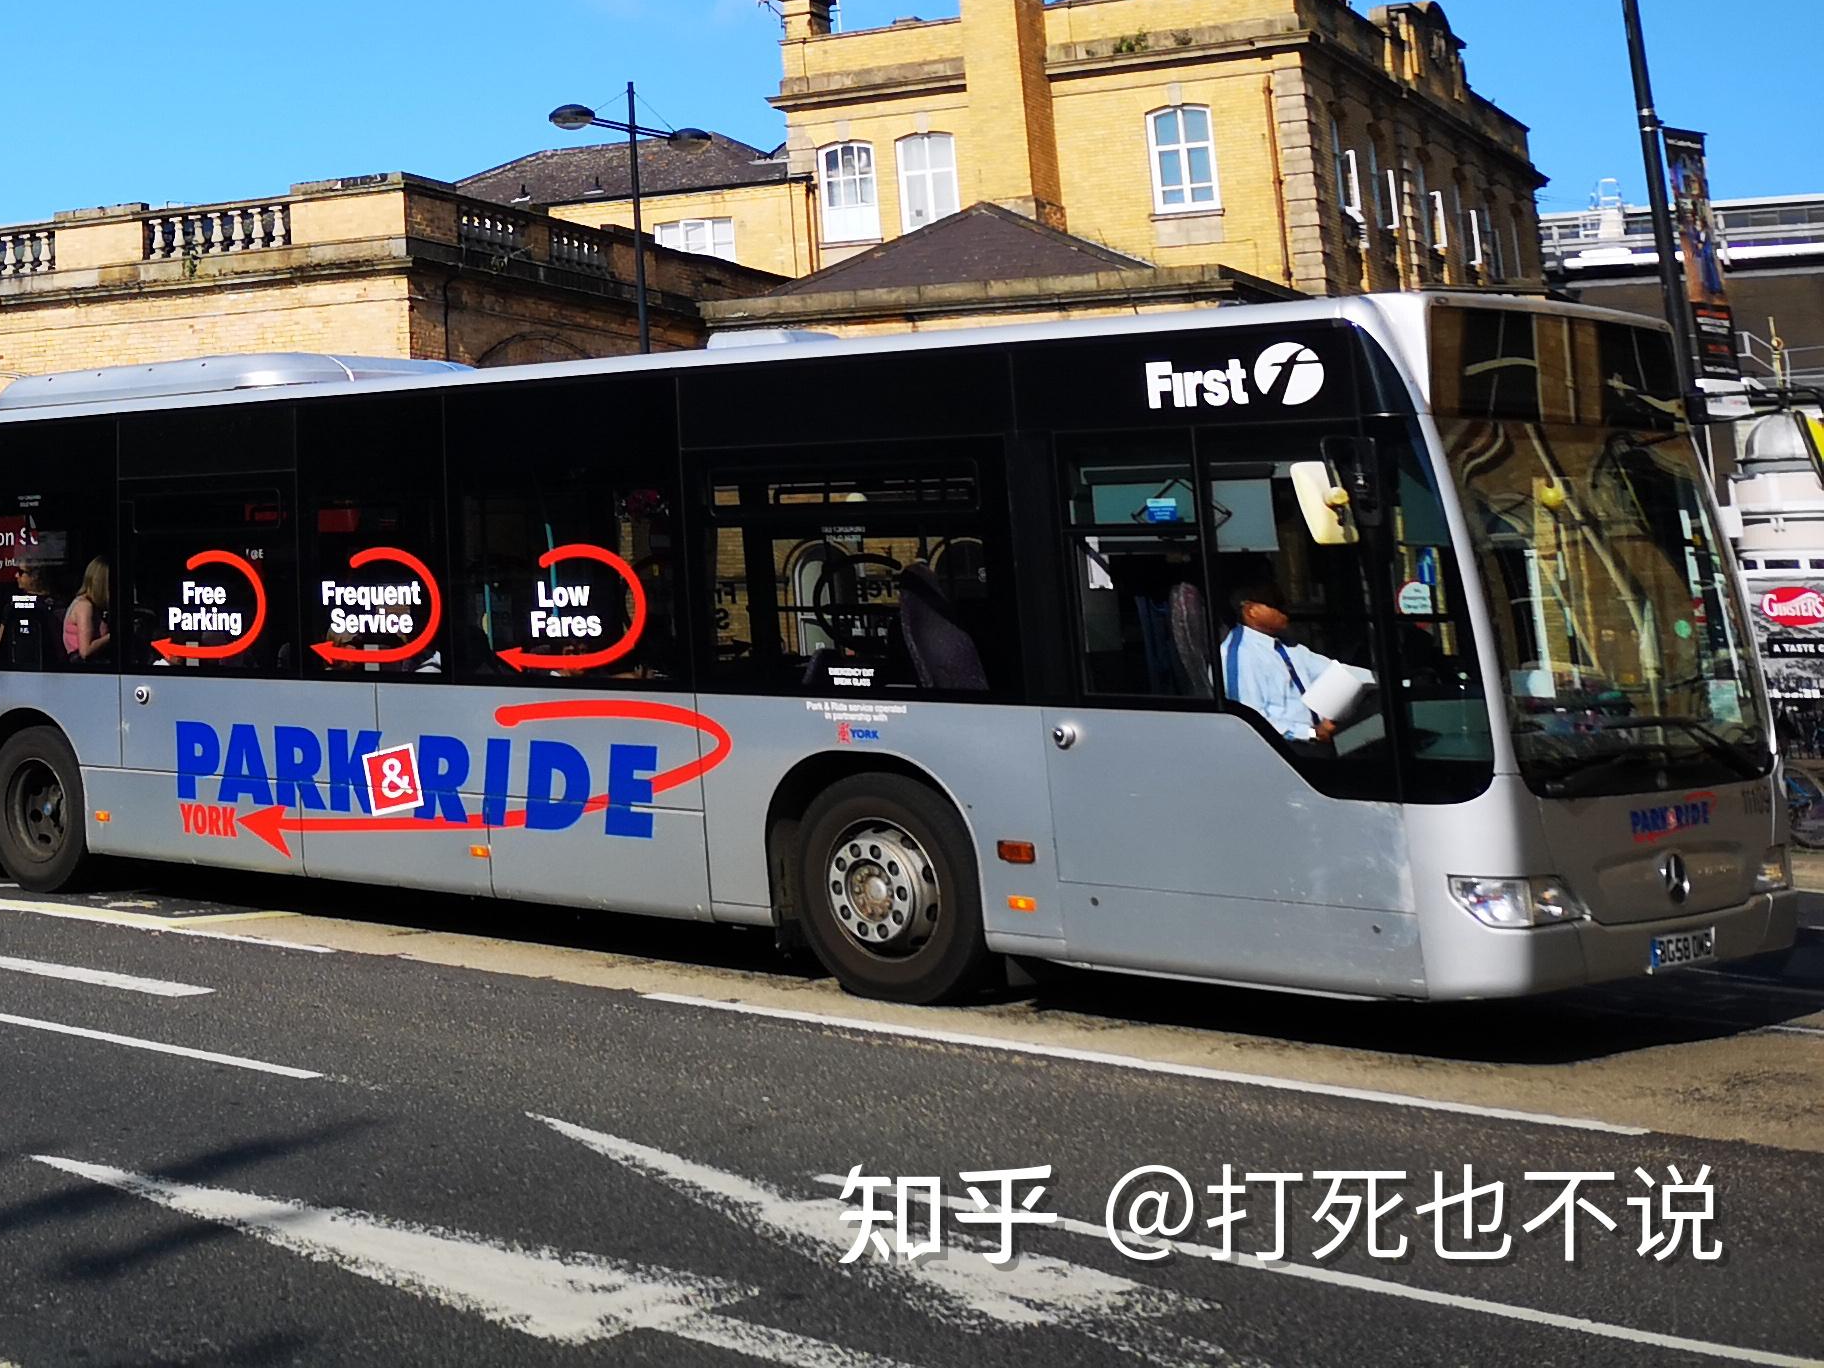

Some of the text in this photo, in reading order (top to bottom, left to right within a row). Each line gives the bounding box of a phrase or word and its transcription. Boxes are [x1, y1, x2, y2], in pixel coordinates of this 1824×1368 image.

[1144, 358, 1249, 409] First
[182, 581, 227, 605] Free
[322, 580, 421, 610] Frequent
[536, 580, 590, 608] Low
[168, 607, 242, 636] Parking
[330, 608, 414, 634] Service
[530, 610, 602, 638] Fares
[1773, 643, 1781, 653] A
[1782, 643, 1815, 653] TASTE
[806, 701, 824, 711] Park
[830, 701, 847, 712] Ride
[850, 728, 879, 740] YORK
[176, 720, 658, 839] PARK & RIDE
[179, 803, 238, 838] YORK
